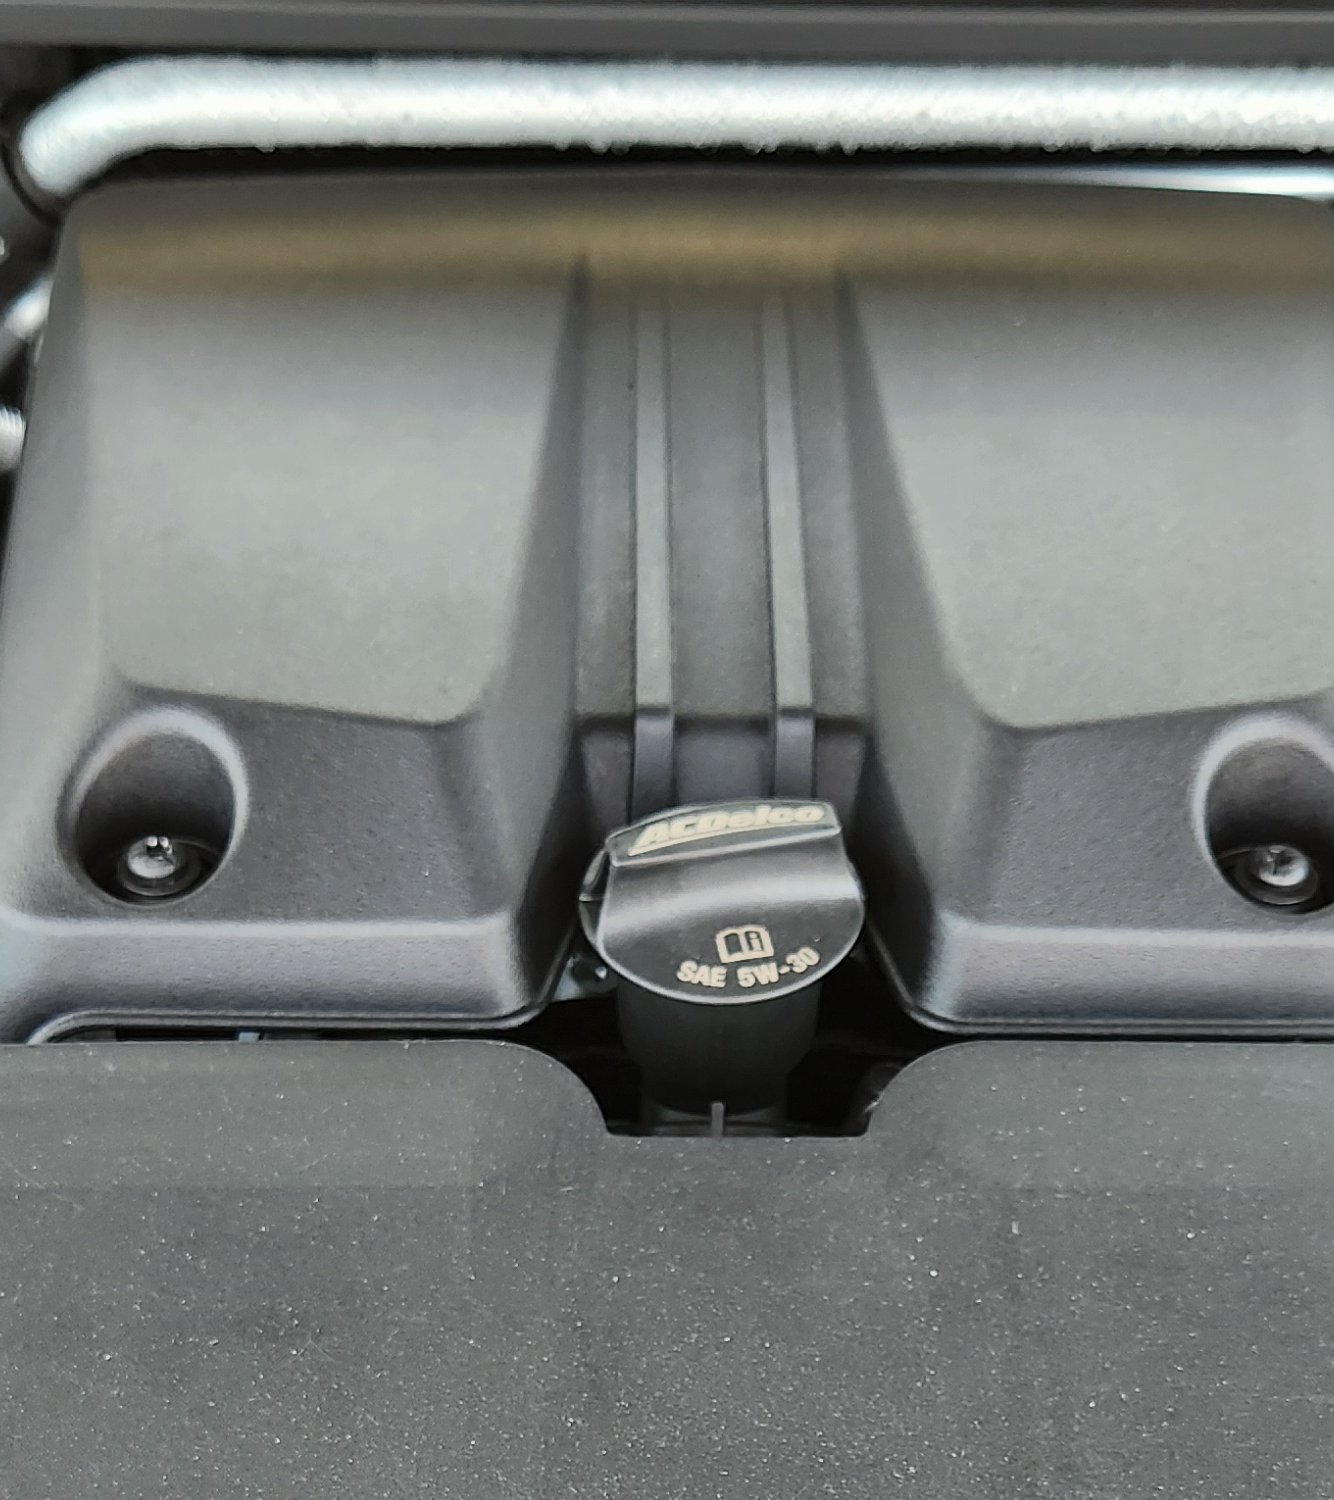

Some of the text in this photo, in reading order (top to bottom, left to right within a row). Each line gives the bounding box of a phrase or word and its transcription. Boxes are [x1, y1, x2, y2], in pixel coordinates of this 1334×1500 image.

[628, 805, 824, 856] ACDelco
[676, 947, 821, 988] SAE 5W-30
